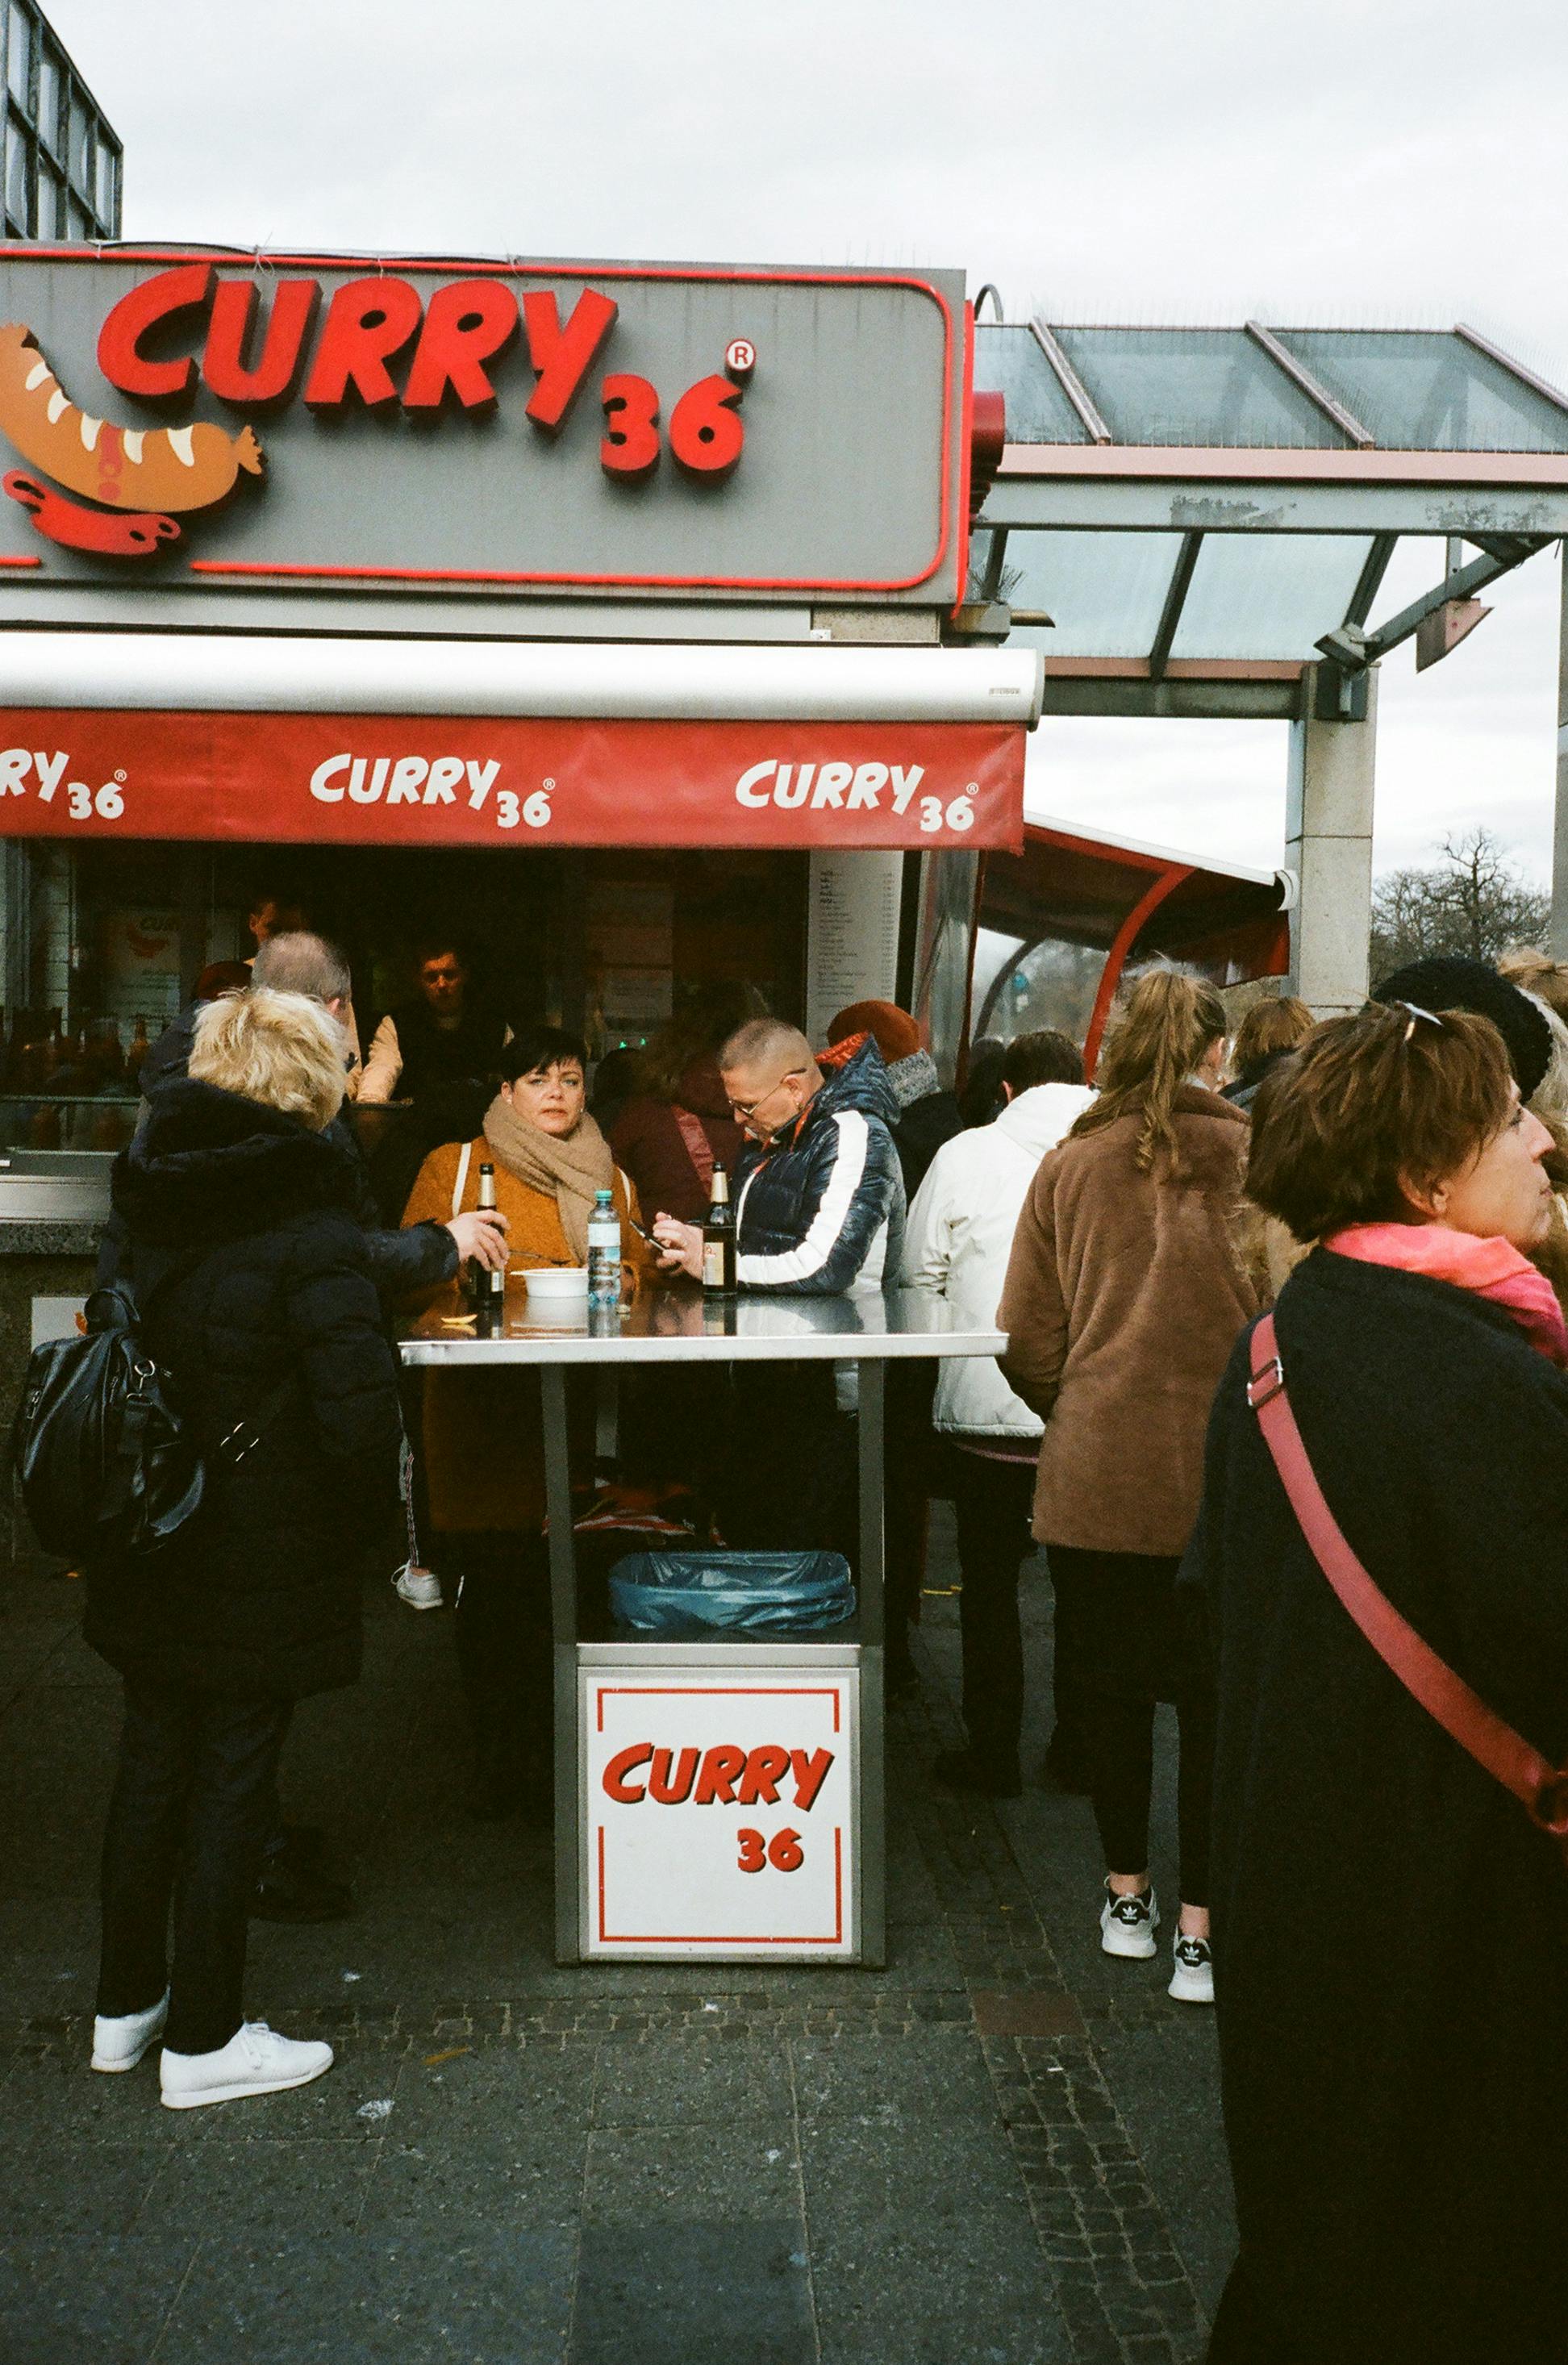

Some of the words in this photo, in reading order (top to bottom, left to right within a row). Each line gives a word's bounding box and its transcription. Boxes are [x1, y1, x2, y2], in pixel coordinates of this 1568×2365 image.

[96, 264, 618, 430] CURRY
[310, 753, 501, 811] CURRY
[735, 759, 924, 815] CURRY
[602, 1741, 836, 1812] CURRY
[736, 1827, 805, 1874] 36
